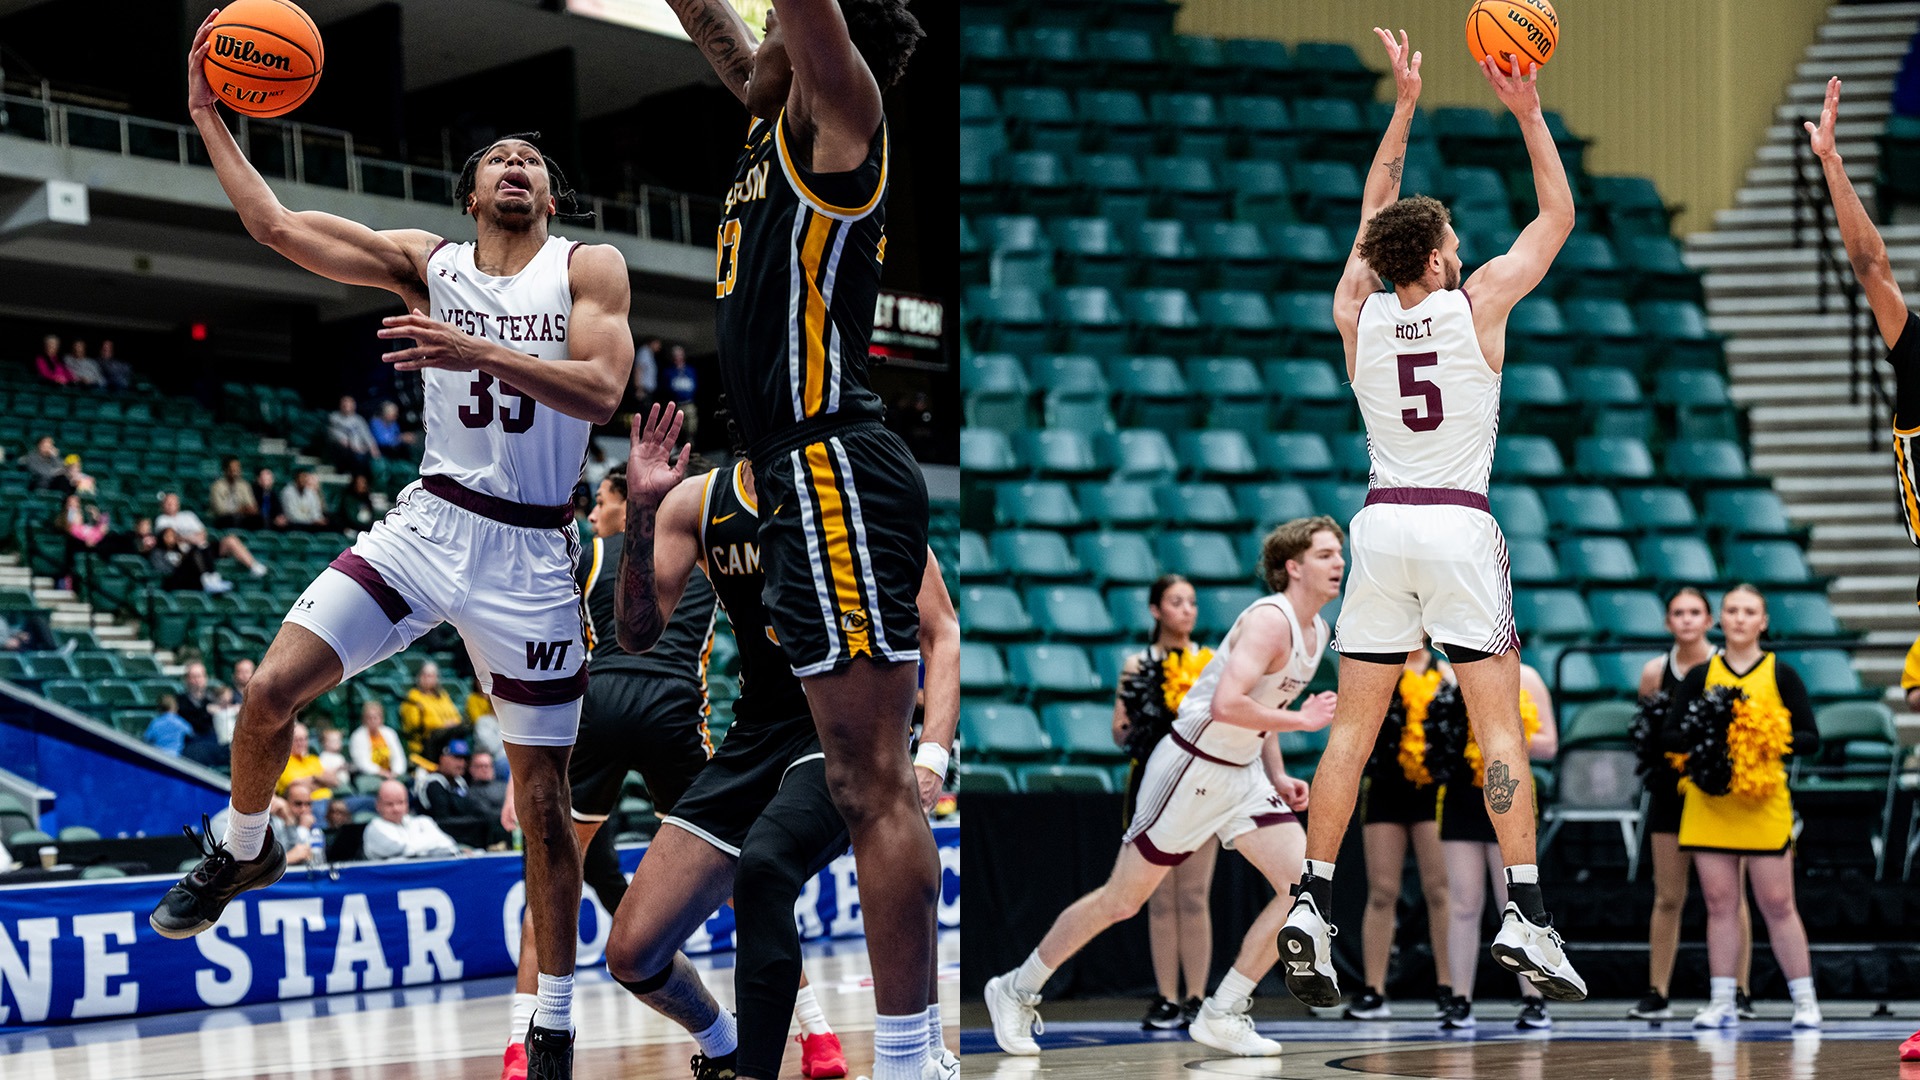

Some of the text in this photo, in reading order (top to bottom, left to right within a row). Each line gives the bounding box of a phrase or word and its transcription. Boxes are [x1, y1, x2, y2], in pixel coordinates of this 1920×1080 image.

[215, 34, 291, 72] Wilson
[1507, 9, 1552, 57] Wilson
[496, 313, 566, 343] TEXAS
[1395, 317, 1433, 340] HOLT
[458, 354, 539, 434] 35
[1397, 351, 1444, 432] 5
[526, 639, 573, 671] WT
[194, 887, 464, 1007] STAR
